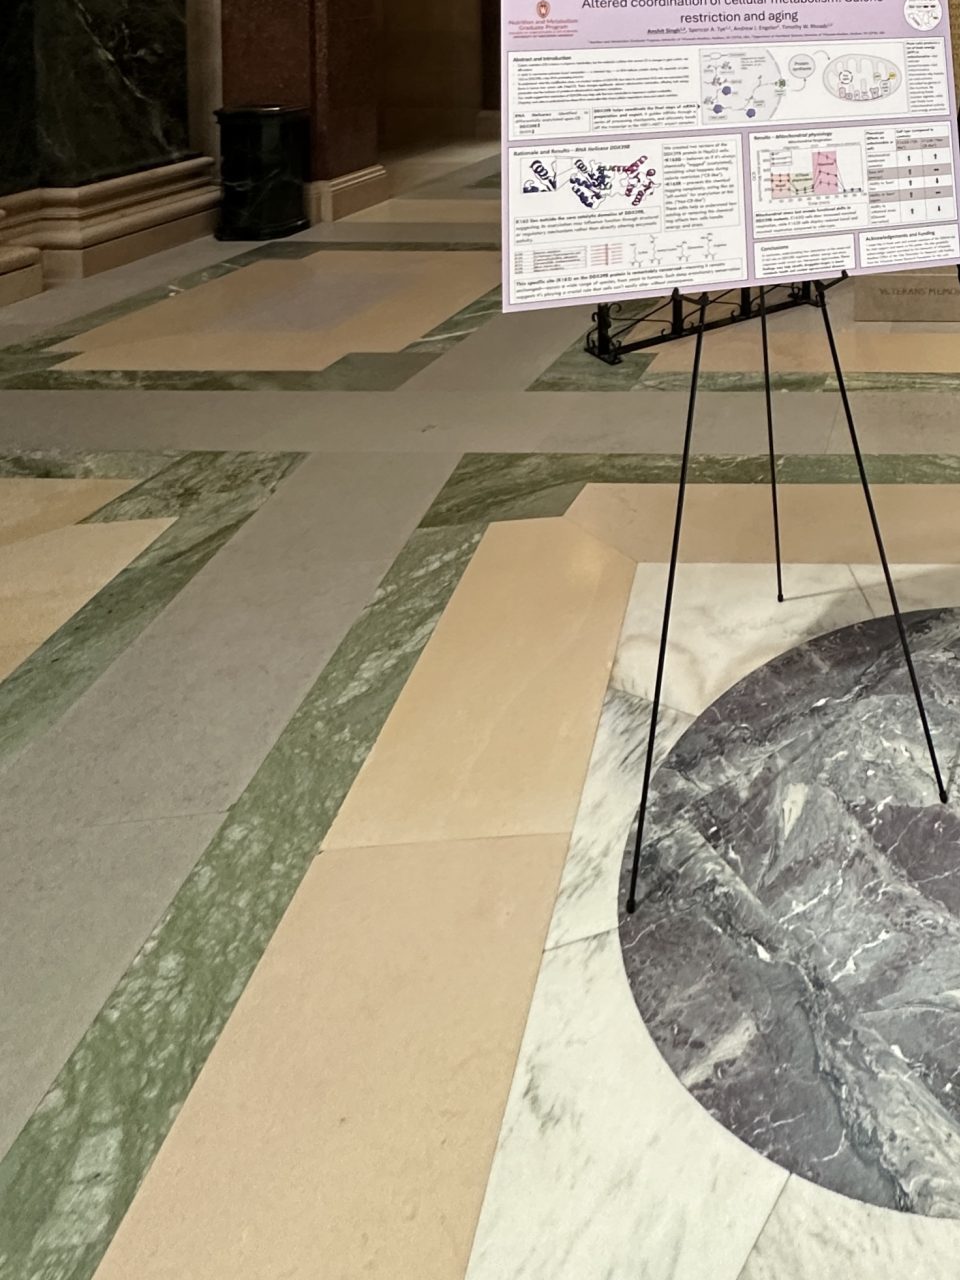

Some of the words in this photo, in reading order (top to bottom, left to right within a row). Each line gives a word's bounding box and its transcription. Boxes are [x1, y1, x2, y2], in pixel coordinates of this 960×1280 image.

[680, 11, 740, 24] restriction
[743, 10, 765, 22] and
[768, 9, 798, 22] aging
